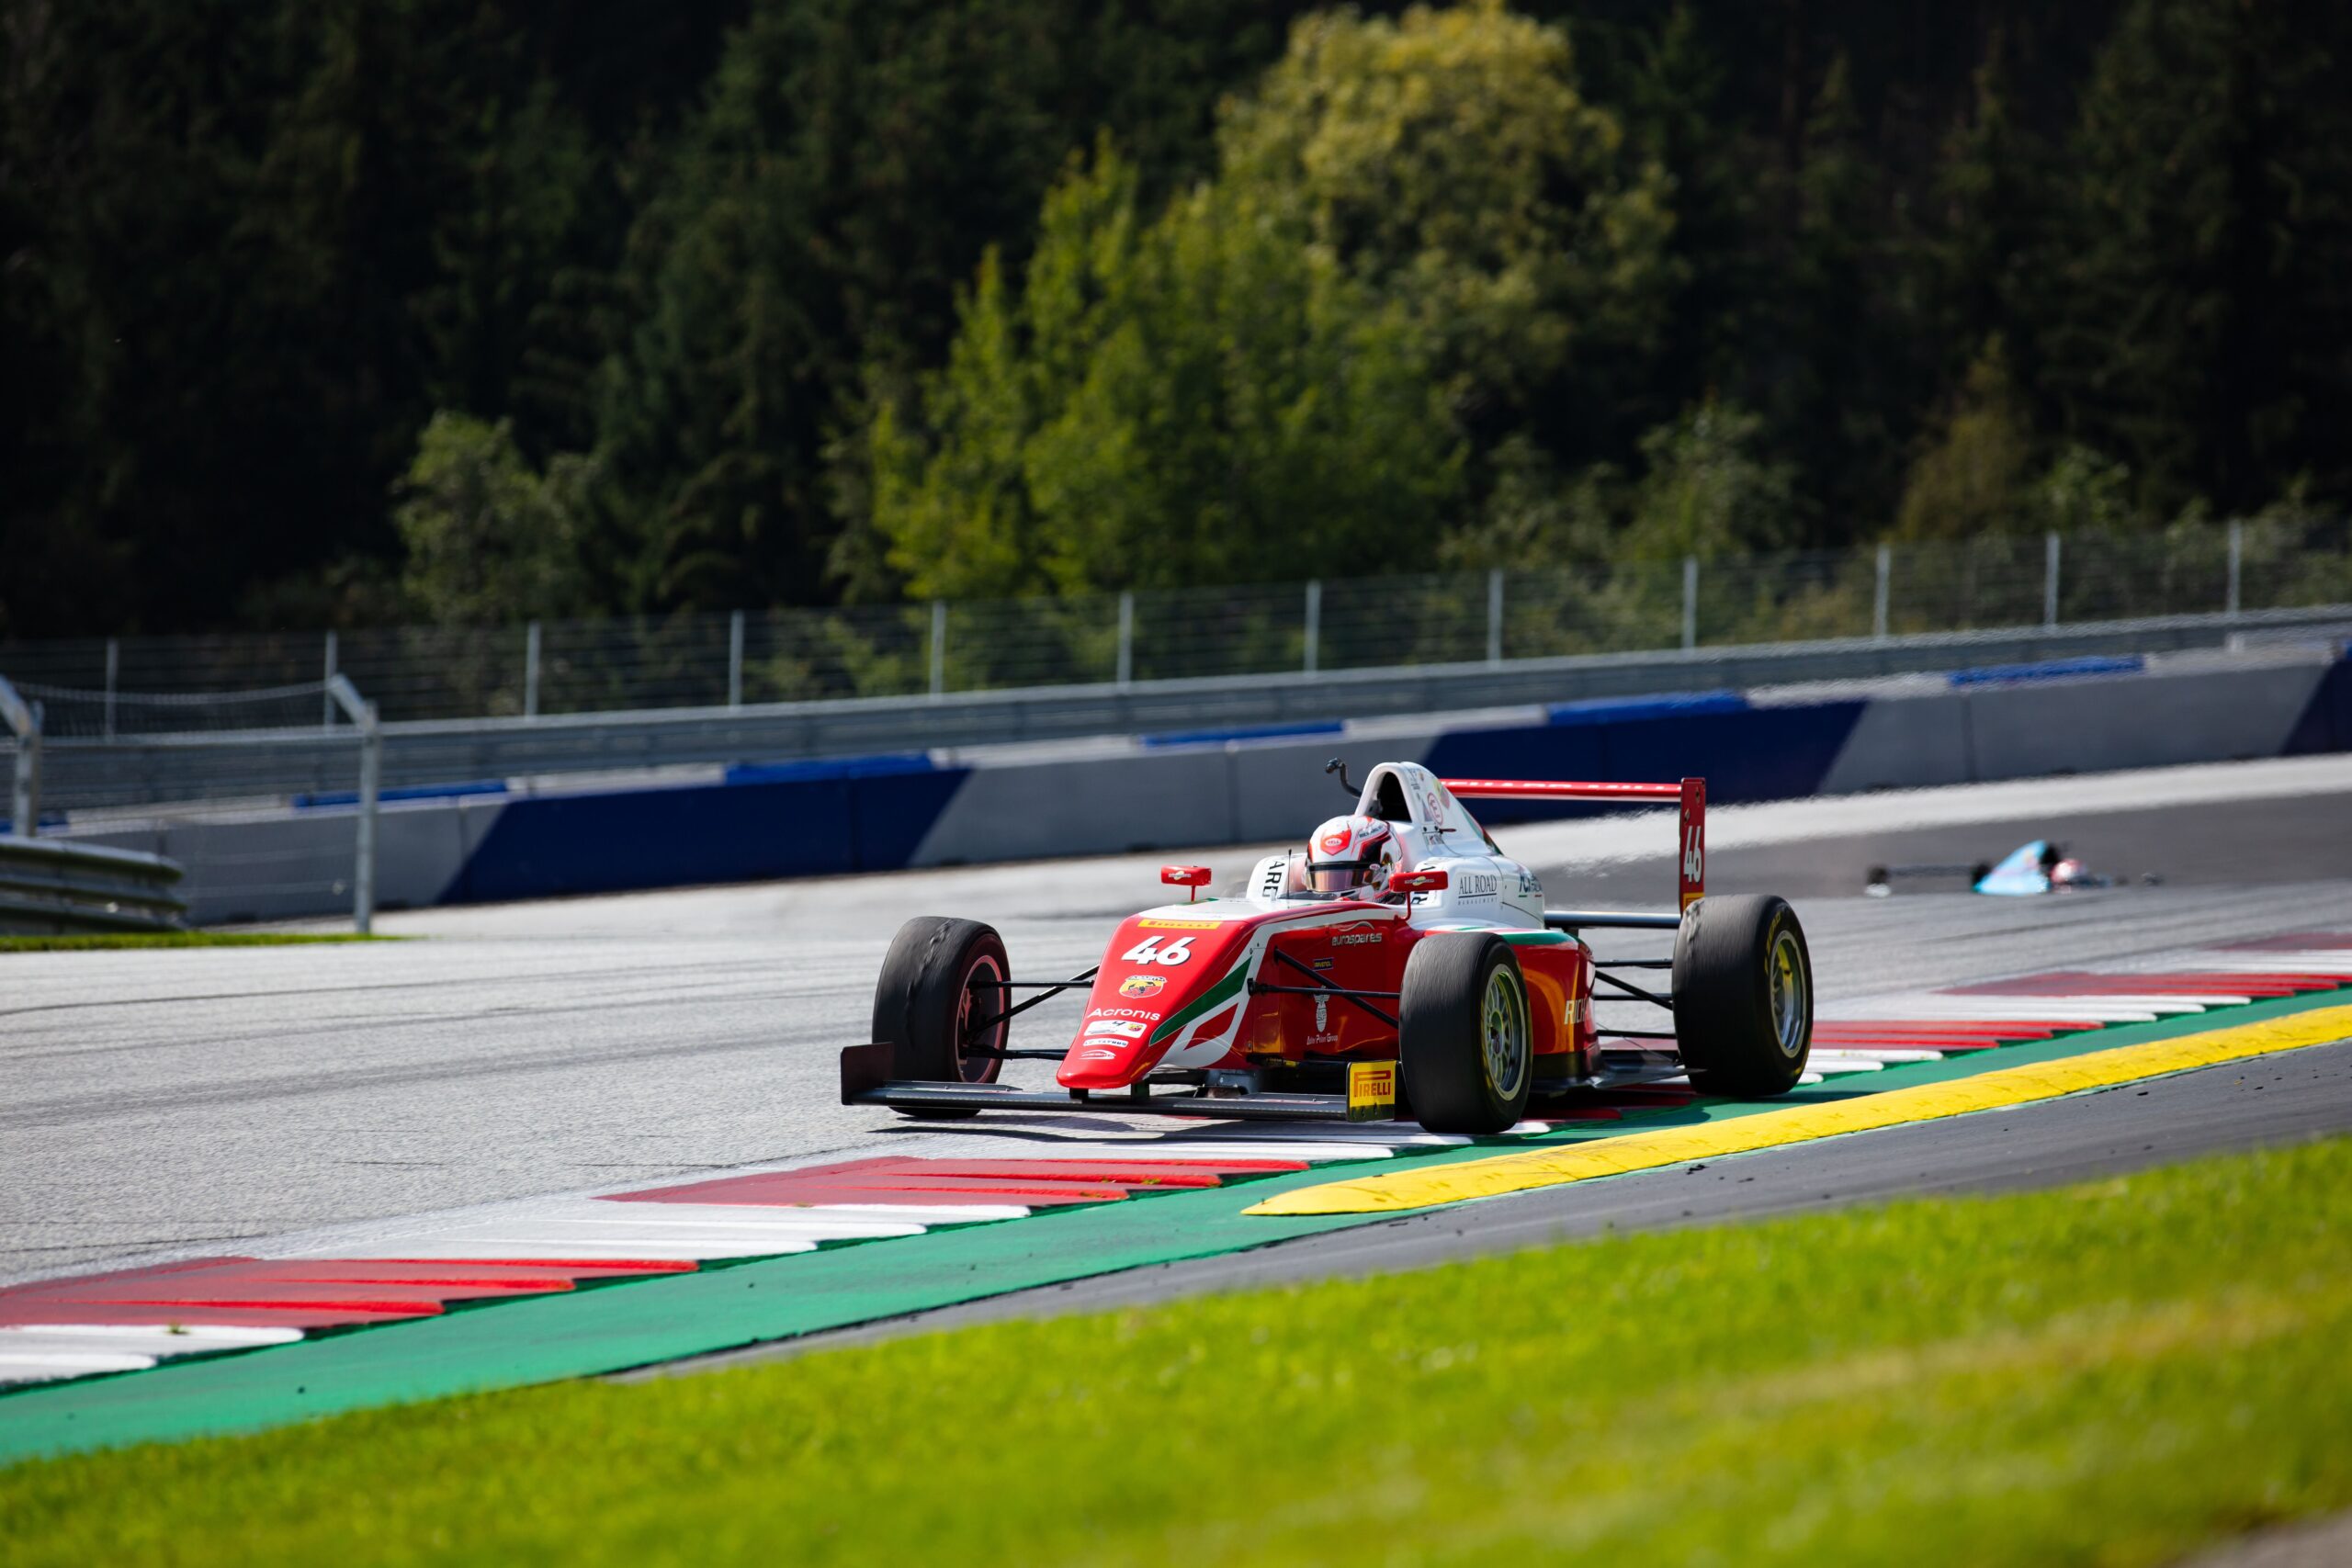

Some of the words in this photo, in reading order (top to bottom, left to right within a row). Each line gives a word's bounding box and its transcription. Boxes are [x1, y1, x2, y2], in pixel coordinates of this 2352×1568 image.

[1684, 825, 1702, 883] 46
[1458, 875, 1473, 895] ALL
[1475, 874, 1498, 894] ROAD
[1121, 935, 1197, 966] 46
[1331, 932, 1383, 947] eurospares
[1087, 1008, 1161, 1021] Acronis
[1353, 1070, 1392, 1098] PIRELLI
